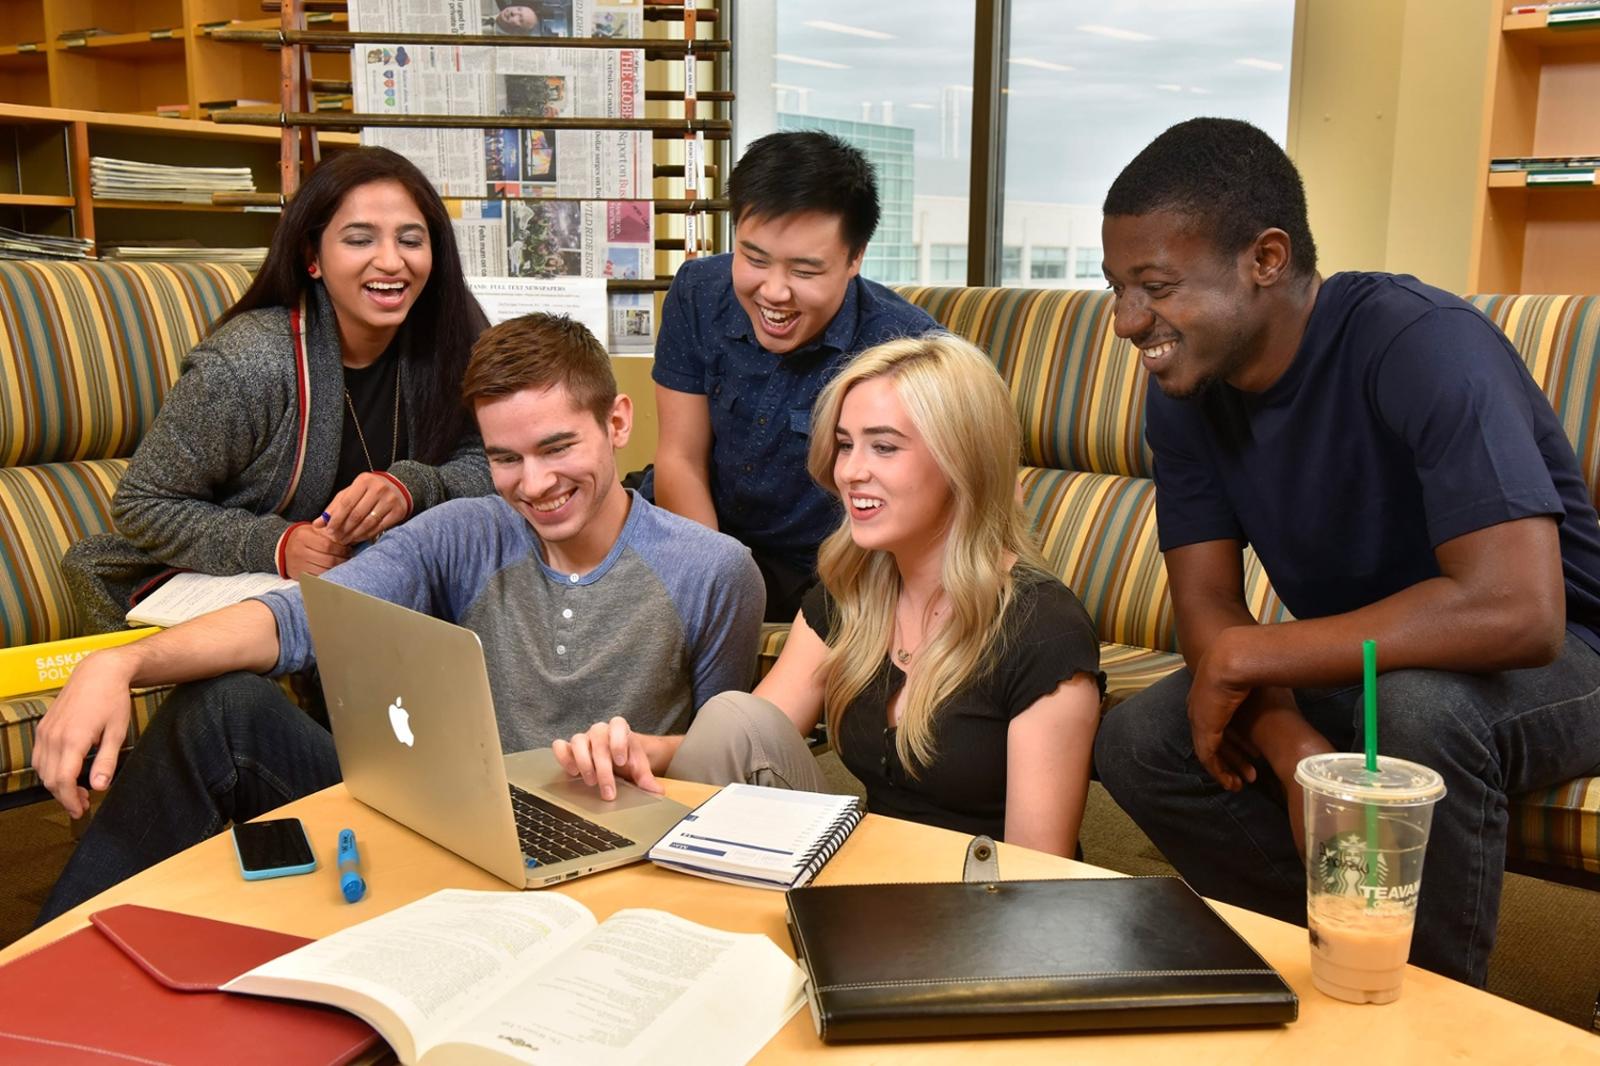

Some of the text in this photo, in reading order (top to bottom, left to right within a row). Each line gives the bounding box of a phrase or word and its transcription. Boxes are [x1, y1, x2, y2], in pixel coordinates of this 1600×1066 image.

[621, 52, 634, 119] THE GLOBE
[616, 131, 628, 163] Report
[619, 164, 626, 177] on
[479, 242, 487, 259] mum
[585, 227, 593, 251] RIDE
[585, 252, 594, 279] ENDS
